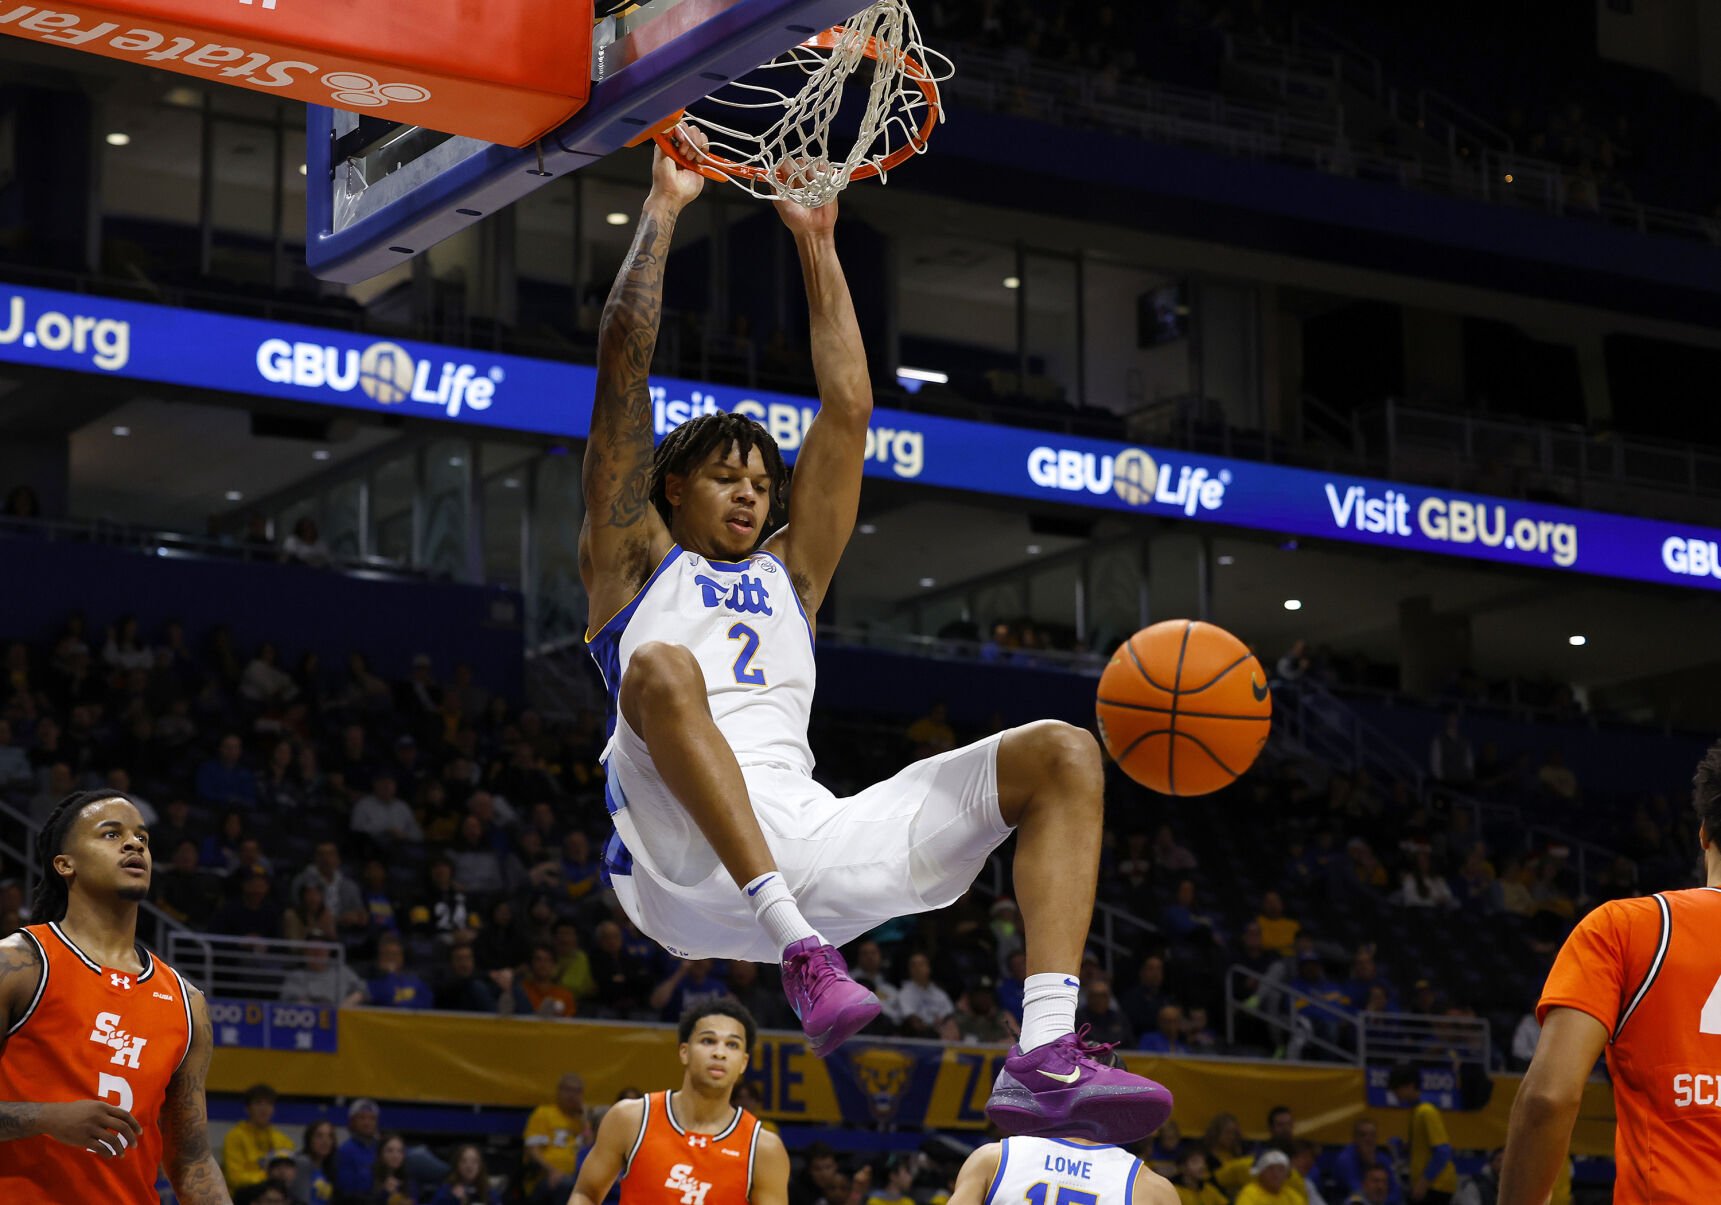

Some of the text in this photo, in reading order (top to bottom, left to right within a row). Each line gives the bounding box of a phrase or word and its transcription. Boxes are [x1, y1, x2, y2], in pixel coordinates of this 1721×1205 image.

[0, 6, 119, 44] Far
[256, 338, 361, 392] GBU
[650, 386, 924, 477] isit GBorg
[1027, 447, 1114, 494] GBU
[1325, 483, 1578, 566] Visit GBU.org
[695, 574, 773, 616] Pitt
[727, 621, 768, 688] 2
[209, 1003, 263, 1024] OO D
[273, 1008, 316, 1029] ZOO
[745, 1042, 807, 1112] HE
[1045, 1154, 1093, 1180] LOWE
